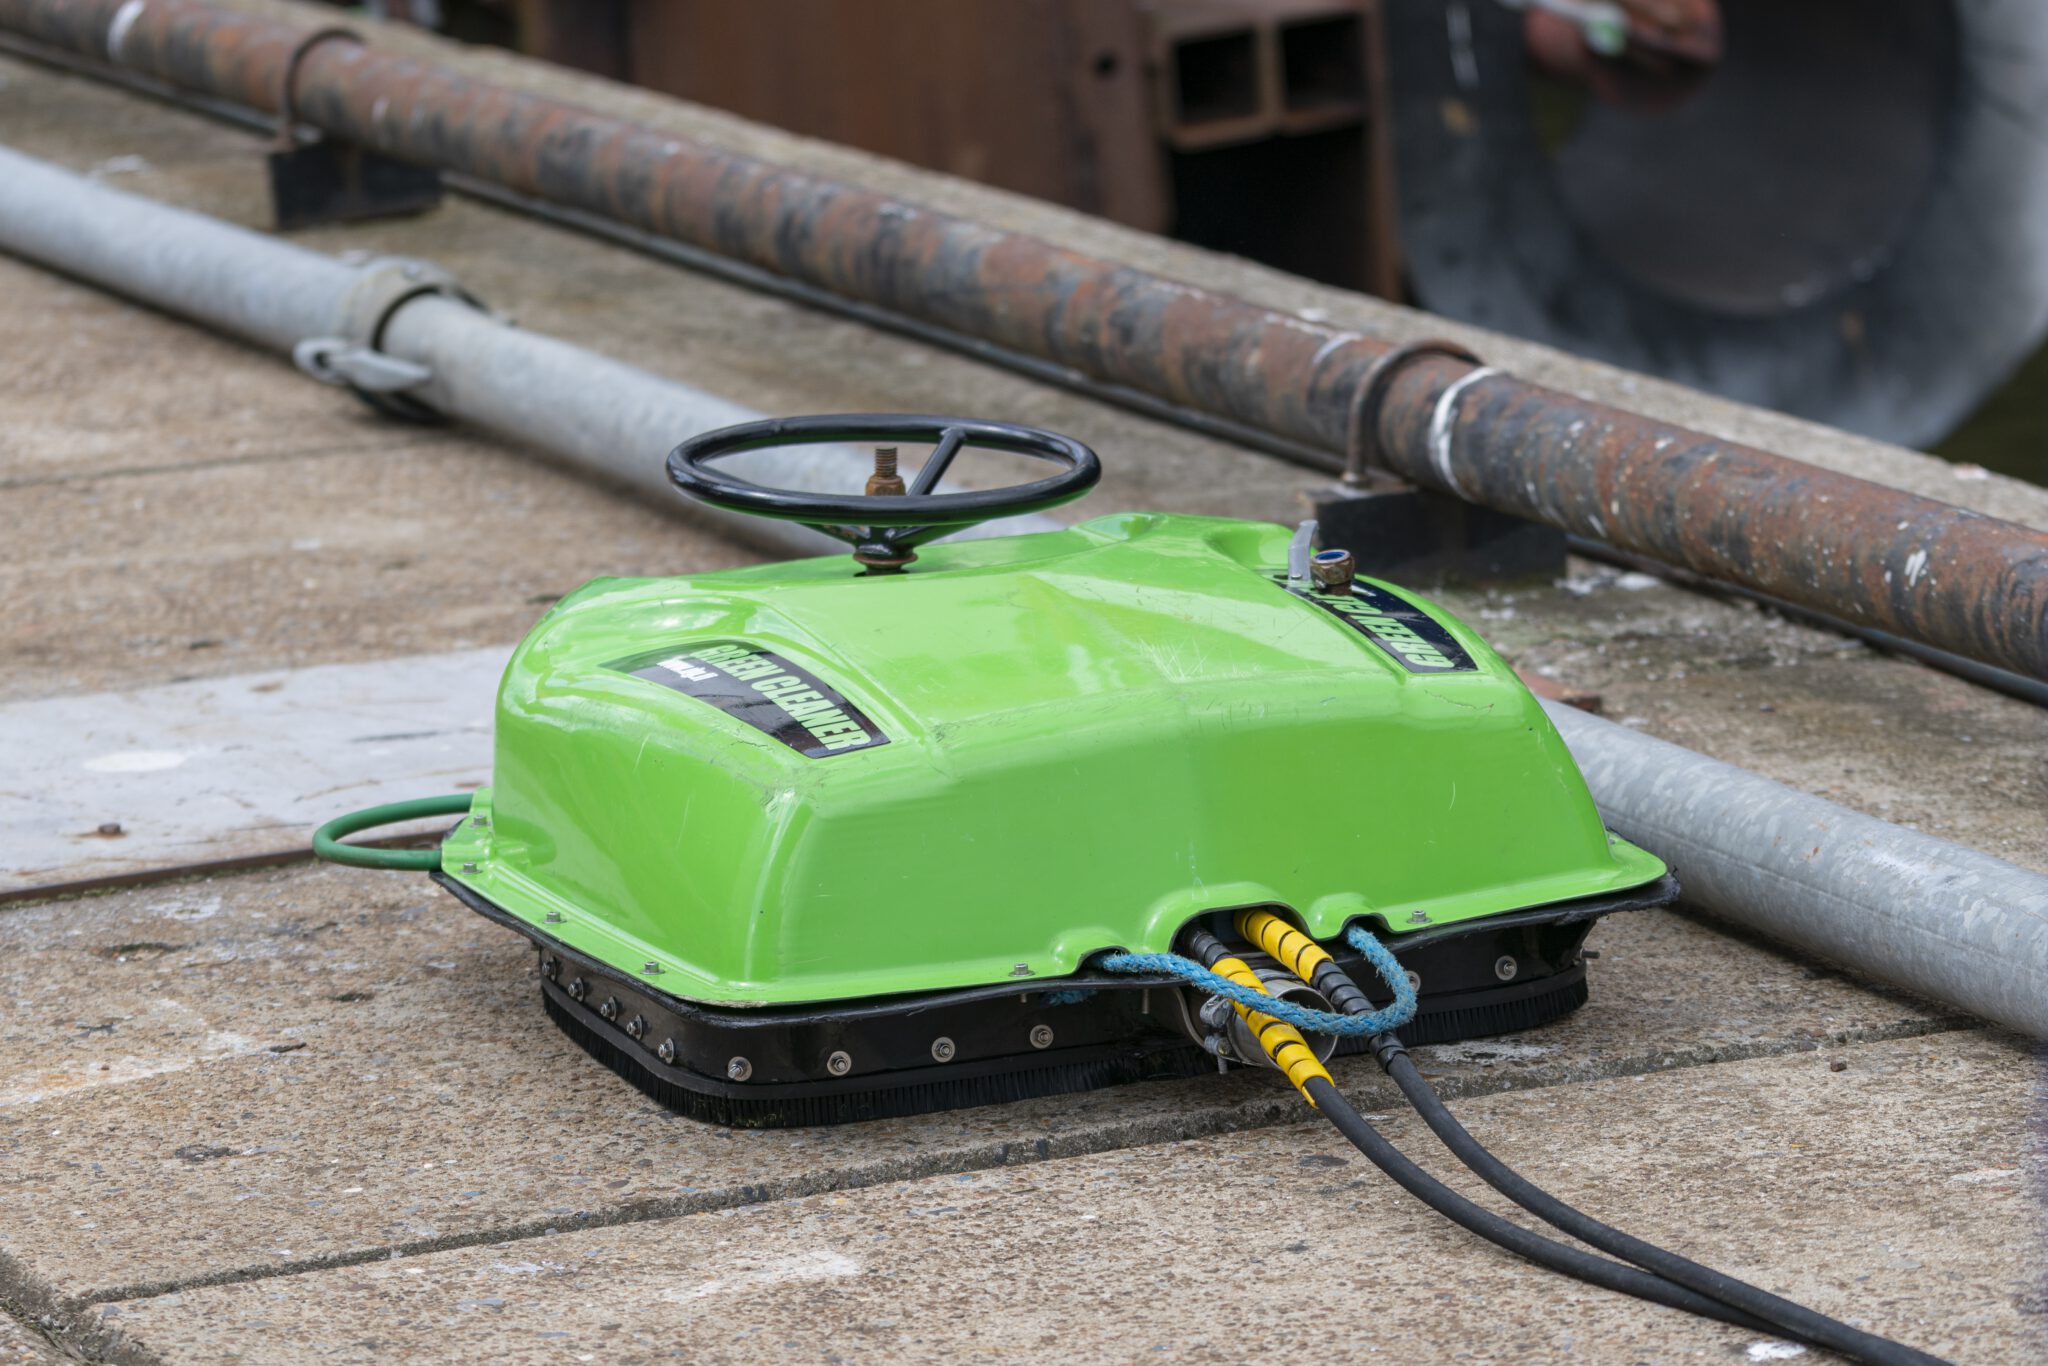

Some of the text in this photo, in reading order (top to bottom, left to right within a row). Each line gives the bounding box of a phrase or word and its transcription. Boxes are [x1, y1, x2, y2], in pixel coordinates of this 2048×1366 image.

[1351, 615, 1454, 668] GREEN
[689, 645, 785, 681] GREEN
[751, 675, 872, 750] CLEANER
